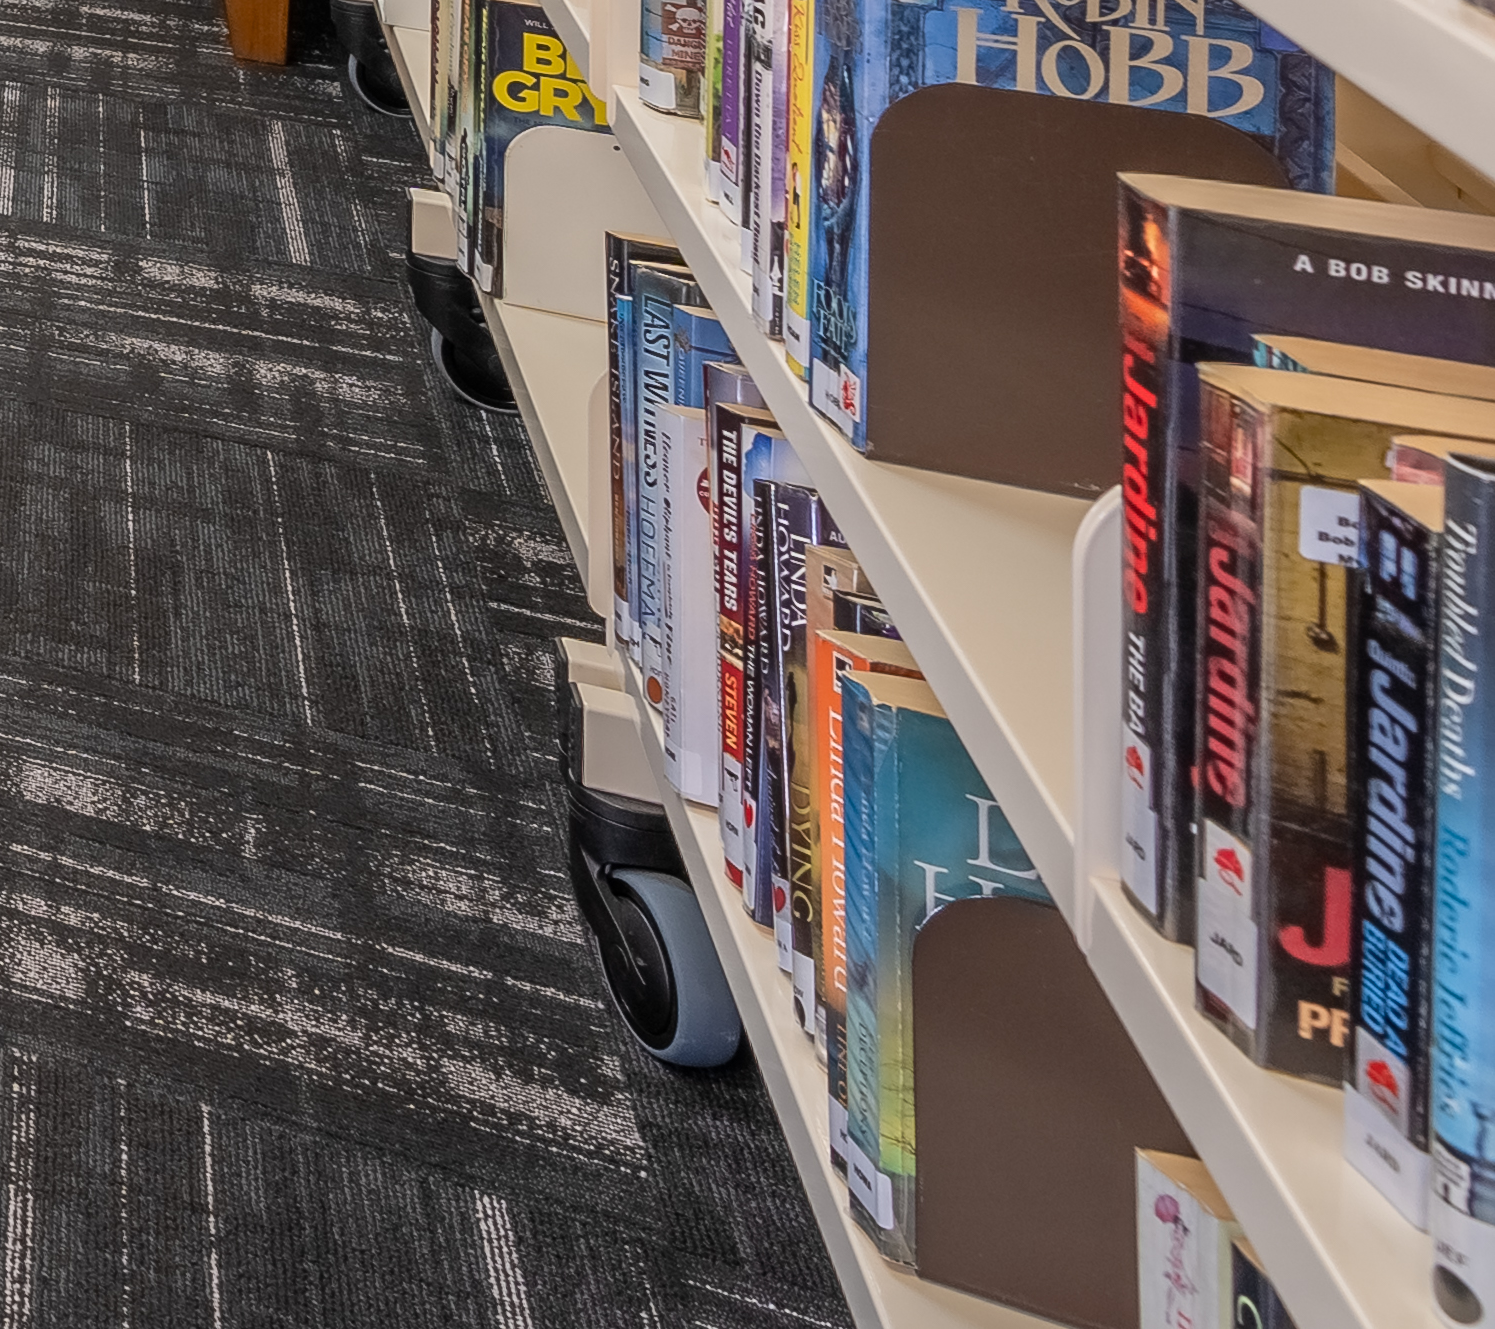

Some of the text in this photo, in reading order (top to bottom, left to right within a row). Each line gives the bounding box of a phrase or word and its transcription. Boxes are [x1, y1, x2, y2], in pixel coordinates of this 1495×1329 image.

[954, 7, 1265, 116] HOBB
[1328, 259, 1389, 284] BOB
[1123, 354, 1157, 614] Jardine
